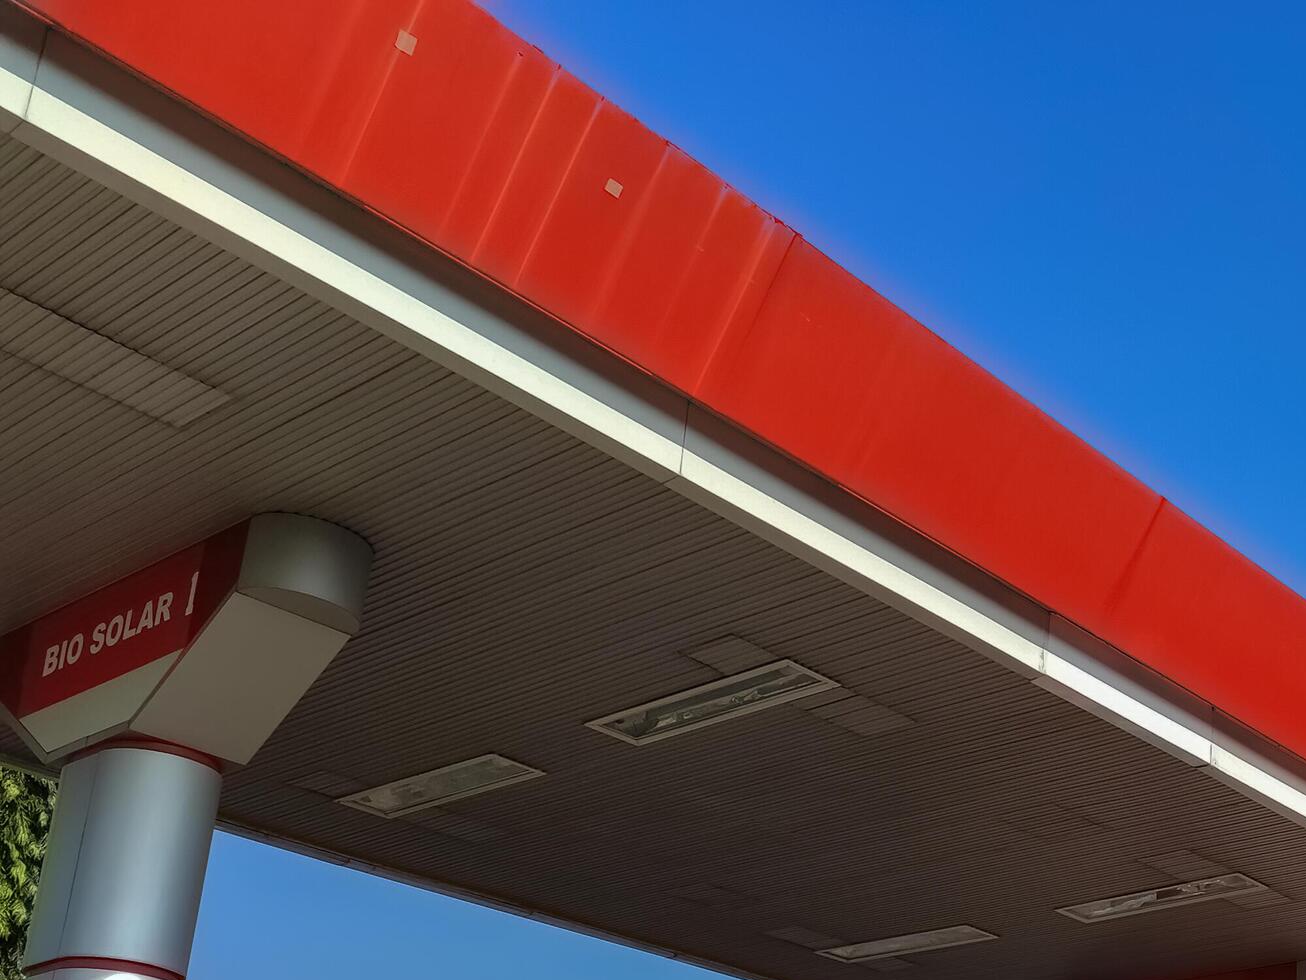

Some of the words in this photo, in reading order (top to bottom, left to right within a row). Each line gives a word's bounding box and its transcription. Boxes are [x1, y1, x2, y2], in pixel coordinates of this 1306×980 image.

[42, 633, 84, 678] BIO
[89, 592, 174, 655] SOLAR
[184, 571, 200, 617] 1
